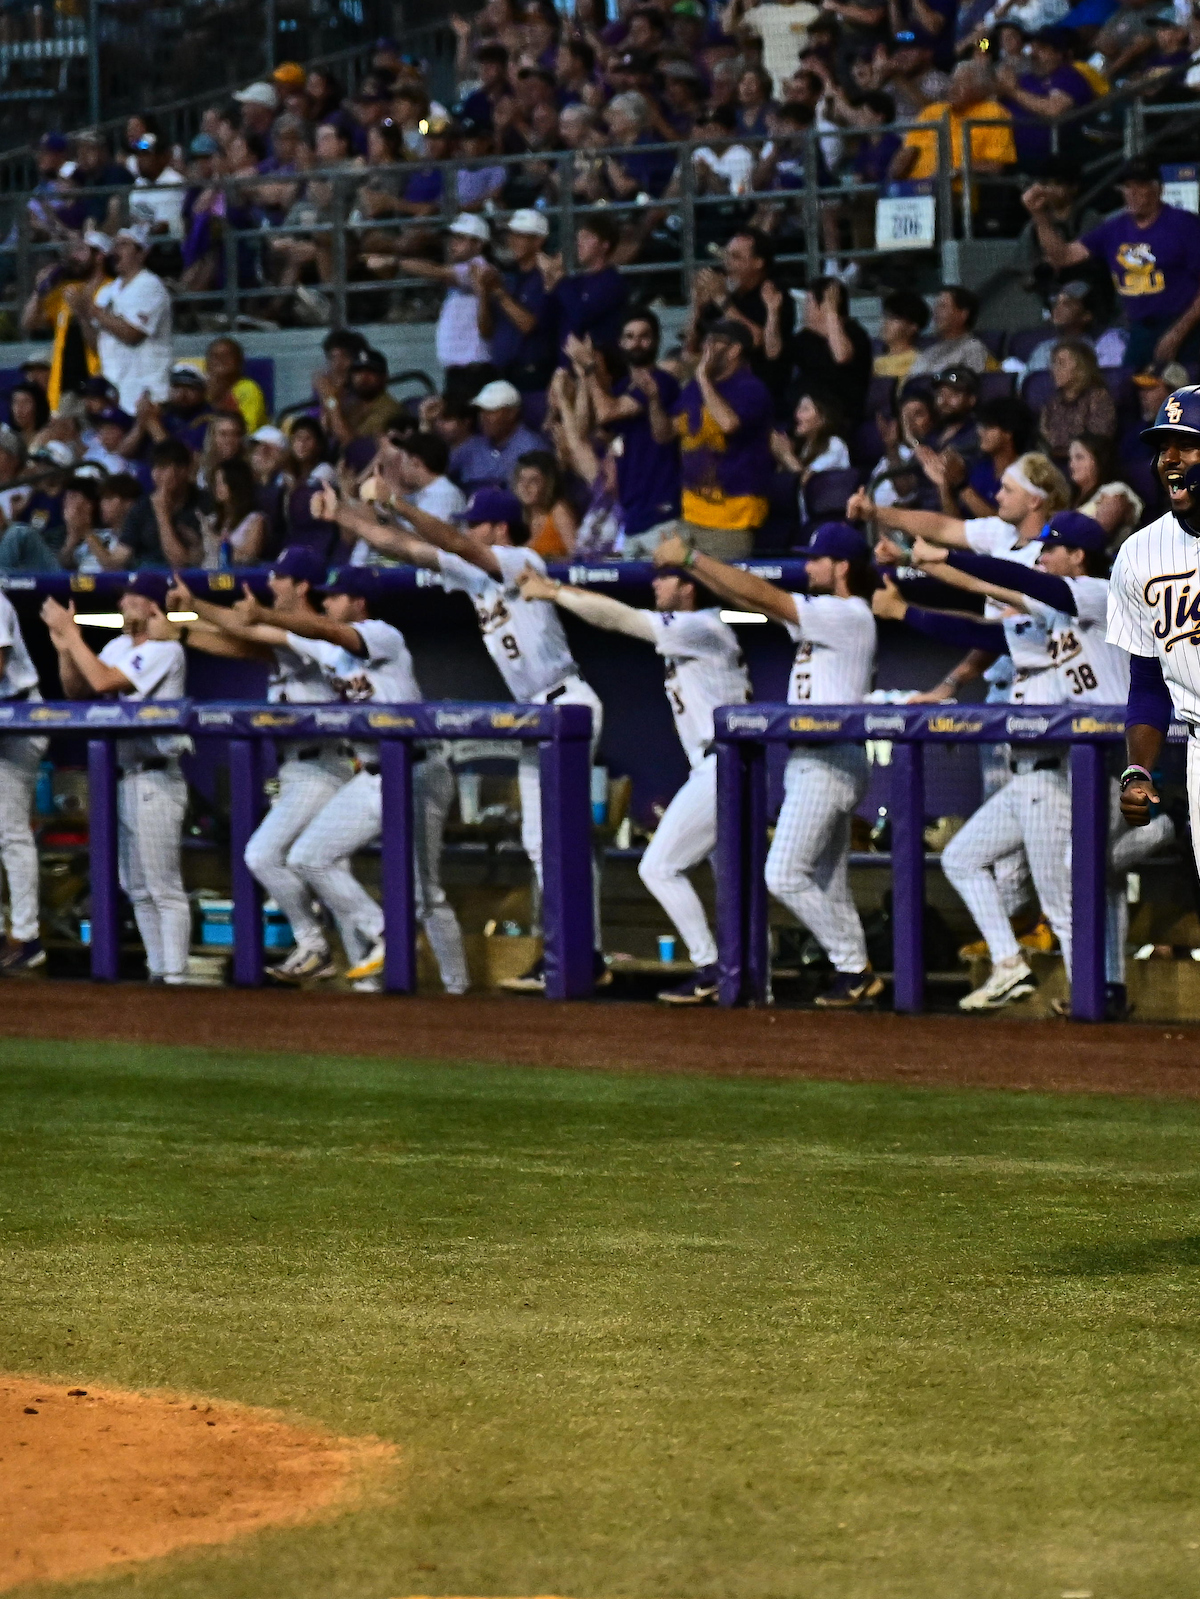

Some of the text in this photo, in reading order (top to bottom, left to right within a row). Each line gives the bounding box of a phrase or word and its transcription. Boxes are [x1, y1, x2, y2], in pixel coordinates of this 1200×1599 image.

[1164, 396, 1184, 424] LSU
[501, 634, 521, 660] 9
[1065, 663, 1099, 696] 38
